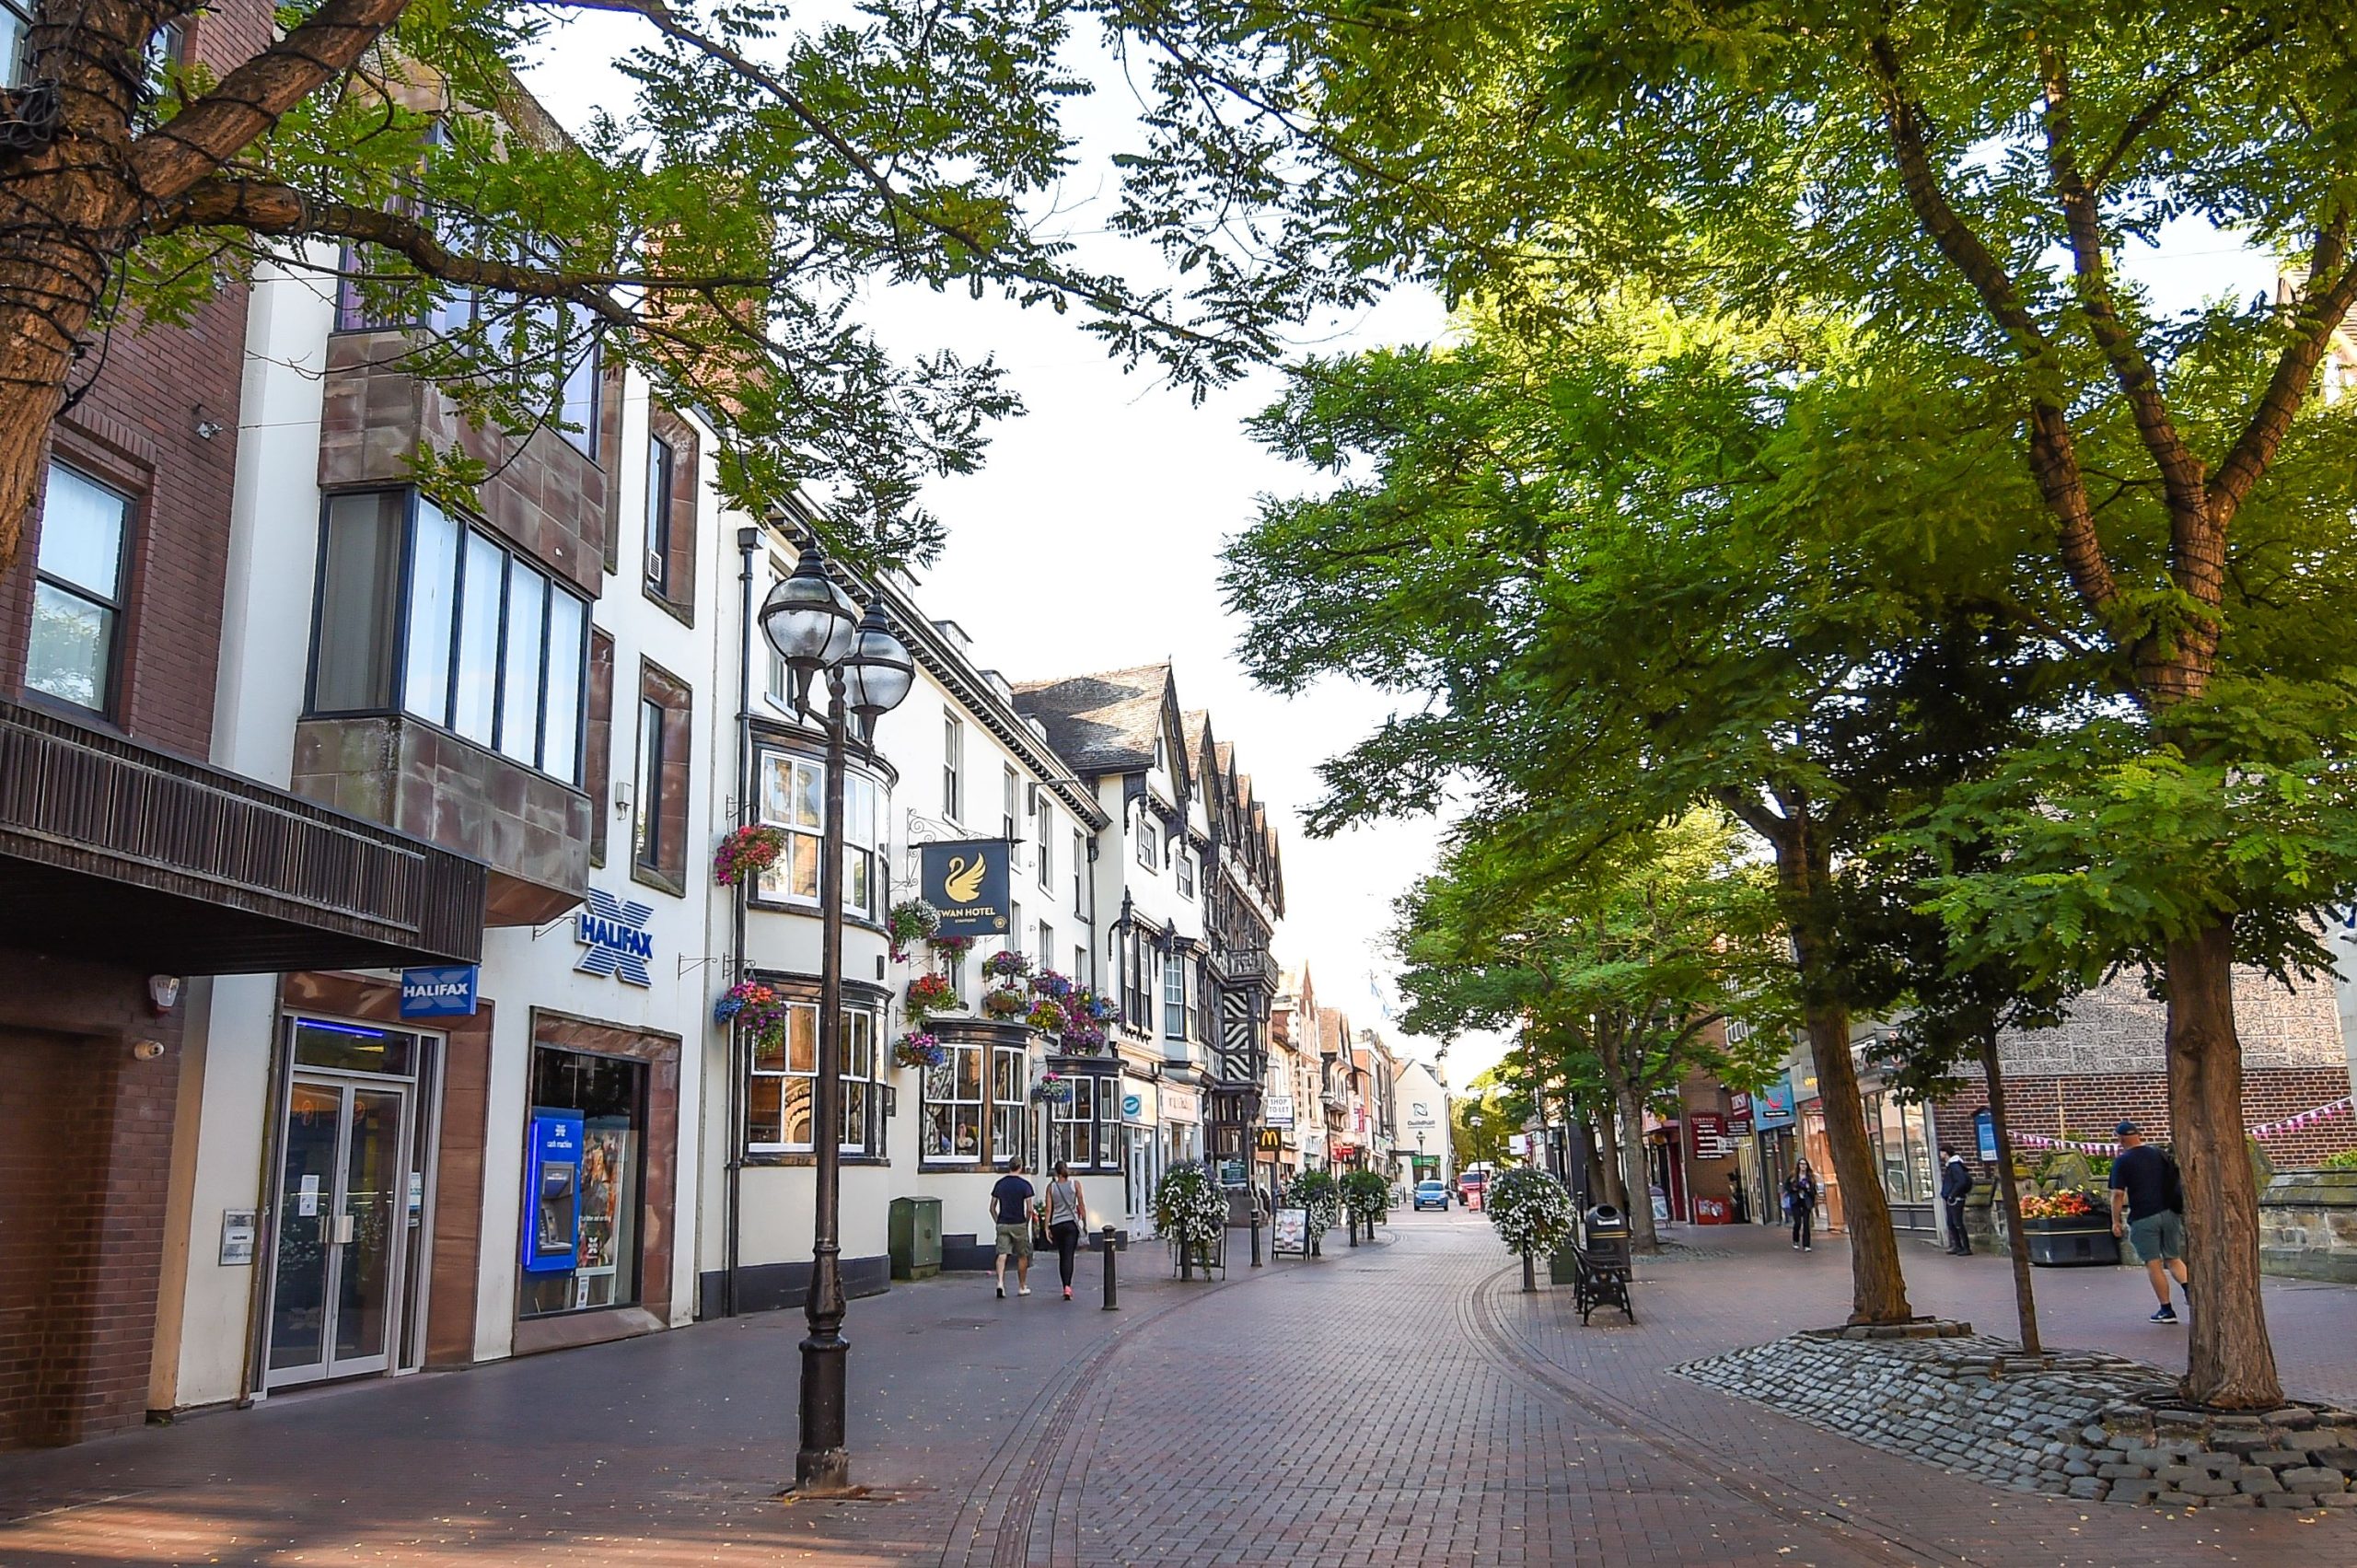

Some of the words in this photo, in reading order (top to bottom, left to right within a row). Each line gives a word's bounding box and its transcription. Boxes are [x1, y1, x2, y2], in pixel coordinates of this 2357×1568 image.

[965, 907, 995, 916] HOTEL
[581, 913, 654, 959] HALIFAX
[403, 982, 469, 998] HALIFAX
